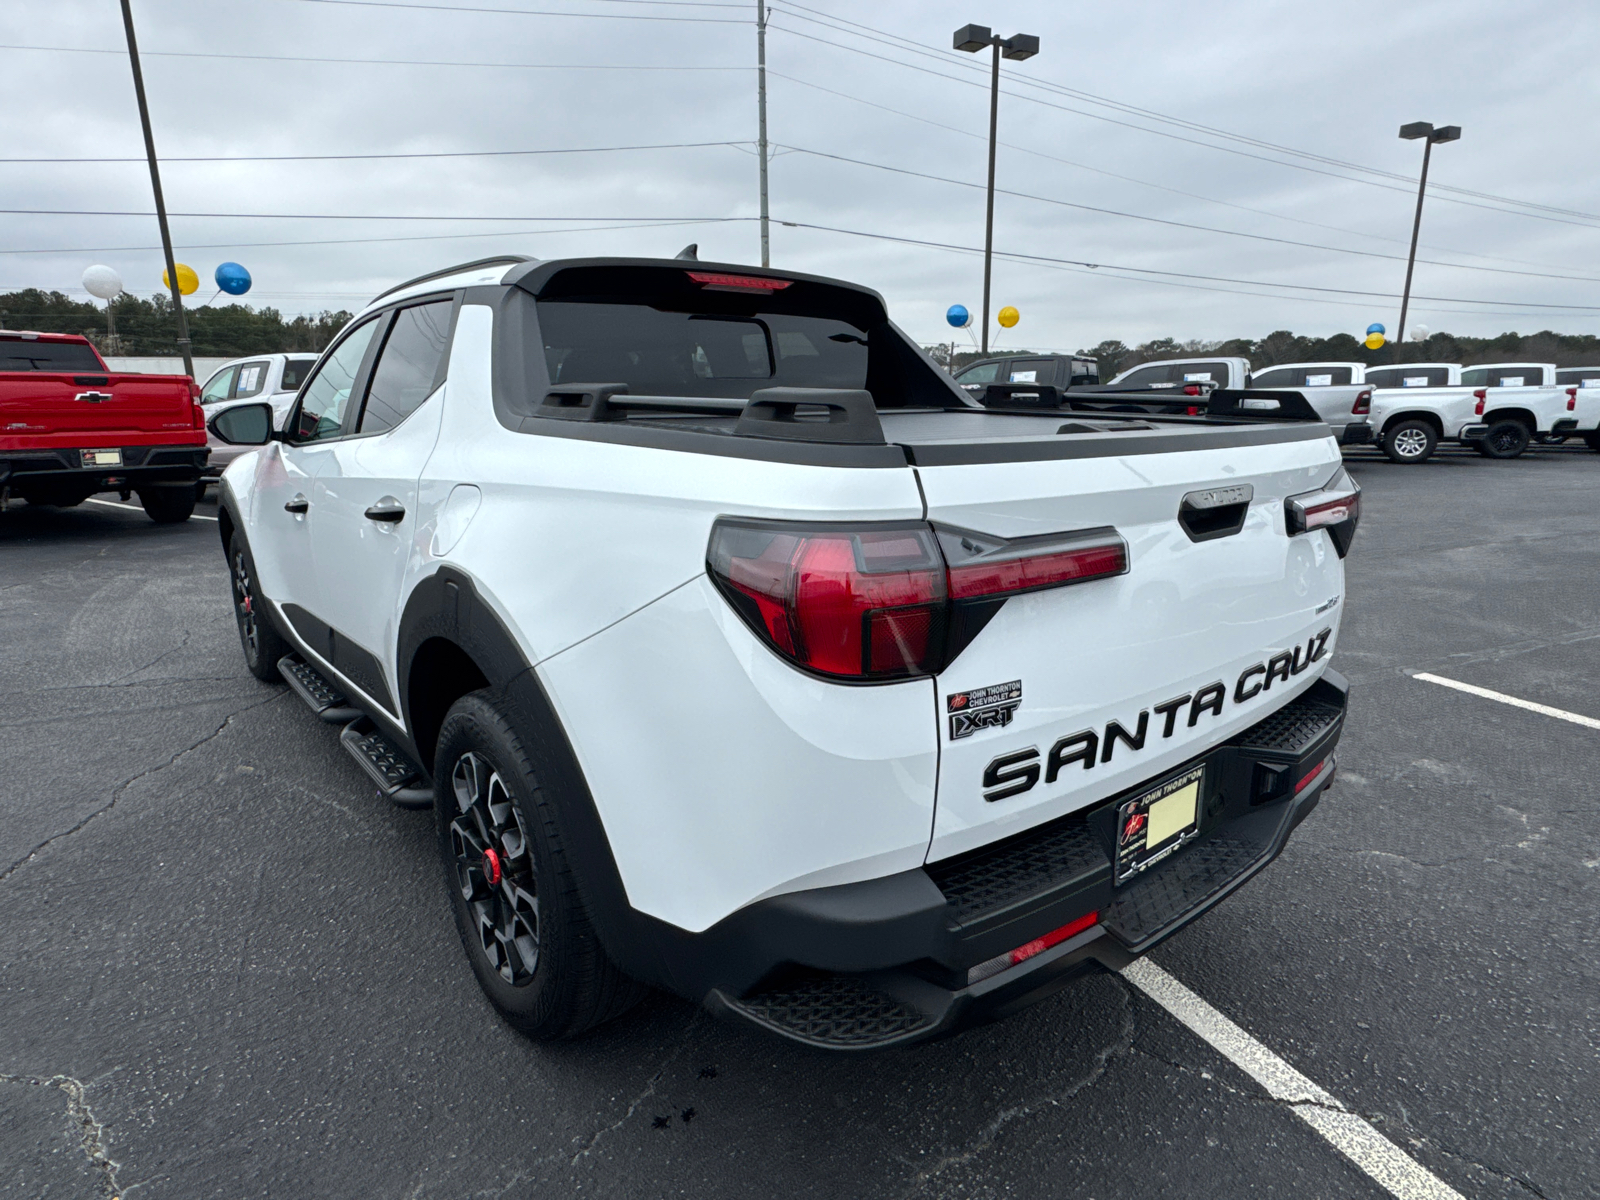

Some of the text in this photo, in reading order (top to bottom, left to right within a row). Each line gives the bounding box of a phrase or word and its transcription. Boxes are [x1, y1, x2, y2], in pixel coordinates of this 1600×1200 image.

[968, 681, 1021, 700] JOHN THORNTON
[968, 692, 1009, 707] CHEVROLET
[950, 699, 1022, 740] XRT
[982, 626, 1332, 802] SANTA CRUZ
